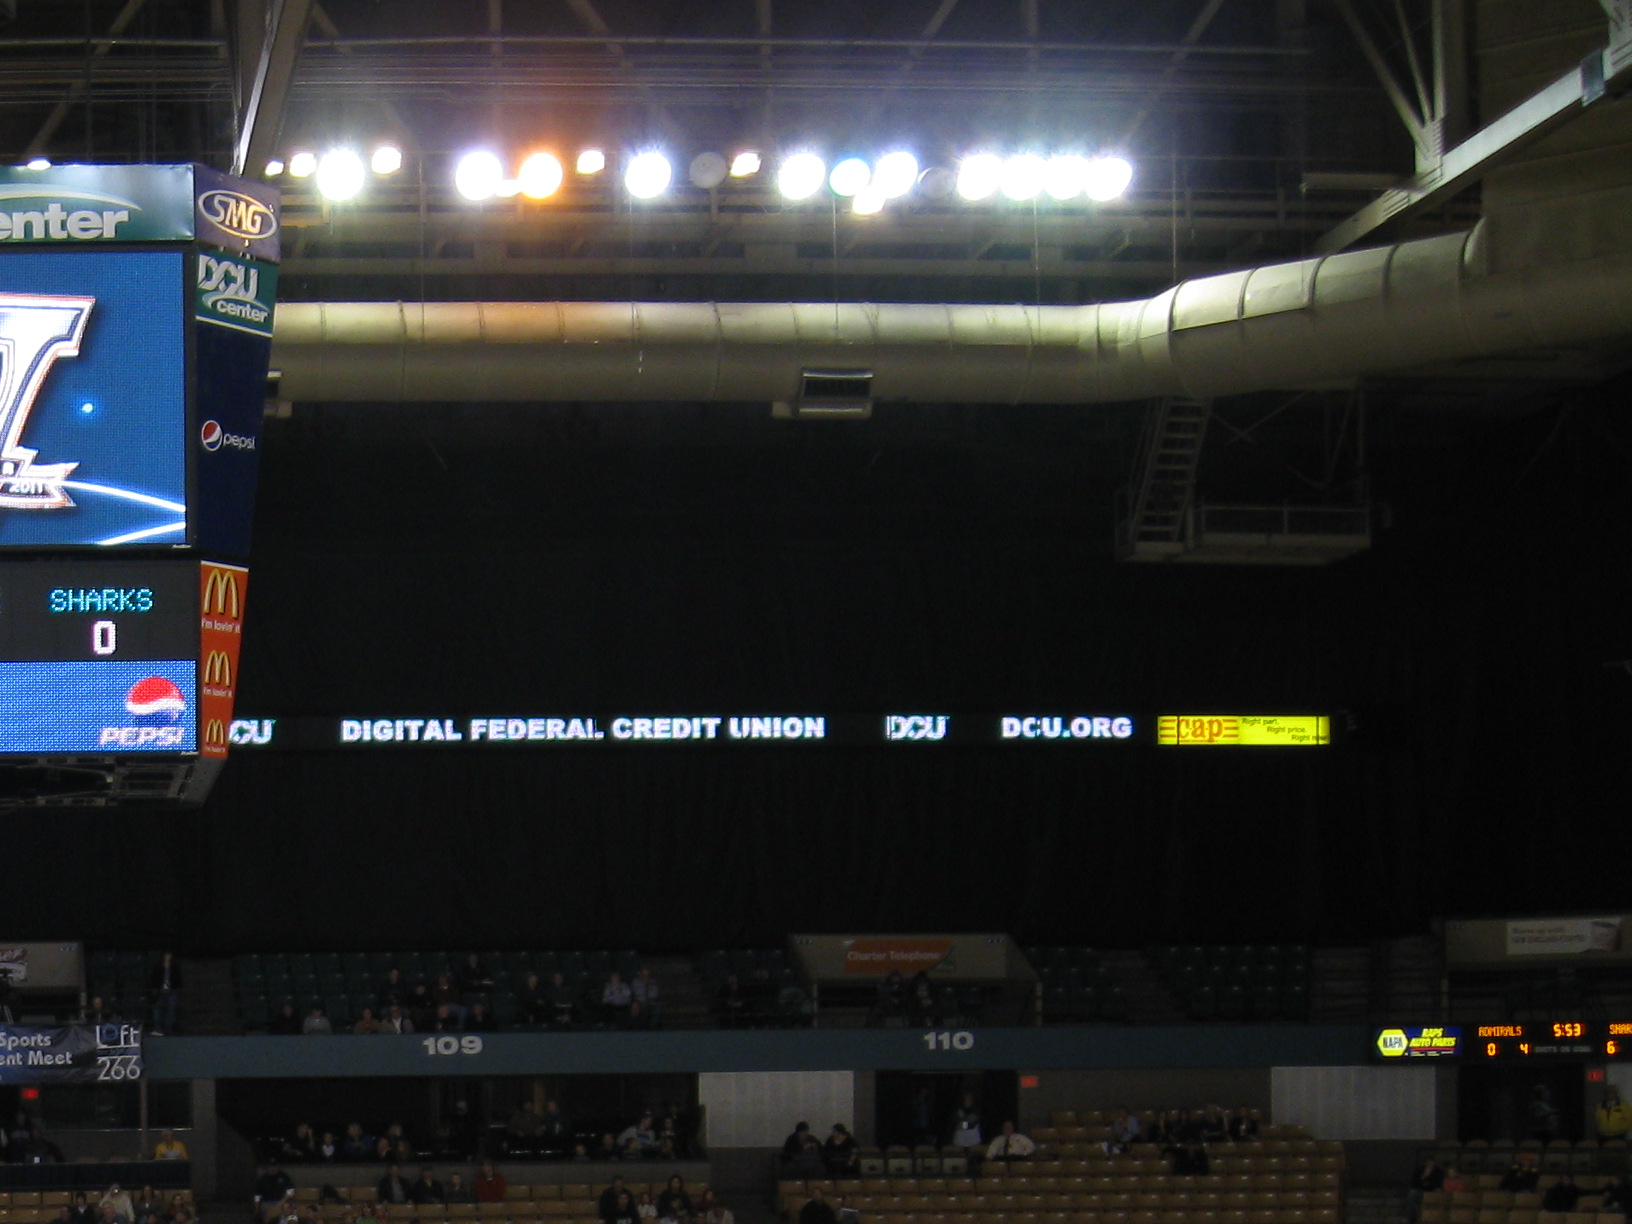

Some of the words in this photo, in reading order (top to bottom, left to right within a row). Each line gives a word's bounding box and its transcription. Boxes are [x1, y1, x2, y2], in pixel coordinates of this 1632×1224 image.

[210, 194, 264, 235] SMG
[198, 255, 258, 300] DCU
[217, 301, 268, 323] center
[222, 433, 256, 450] pepsi
[10, 481, 44, 494] 2011
[50, 587, 154, 612] SHARKS
[91, 620, 117, 655] 0
[341, 719, 461, 743] DIGITAL
[470, 718, 604, 741] FEDERAL
[611, 717, 722, 740] CREDIT
[728, 716, 825, 740] UNION
[885, 715, 949, 741] DCU
[1001, 716, 1133, 741] DCU.ORG
[1242, 718, 1261, 726] Right
[1267, 726, 1286, 735] Right
[98, 726, 185, 746] PEPSI
[1478, 1026, 1522, 1037] ADMIRALS
[1552, 1023, 1582, 1037] 5:53
[422, 1036, 483, 1056] 109
[924, 1031, 974, 1050] 110
[1486, 1042, 1496, 1056] 0
[27, 1051, 73, 1065] Meet
[97, 1057, 141, 1080] 266
